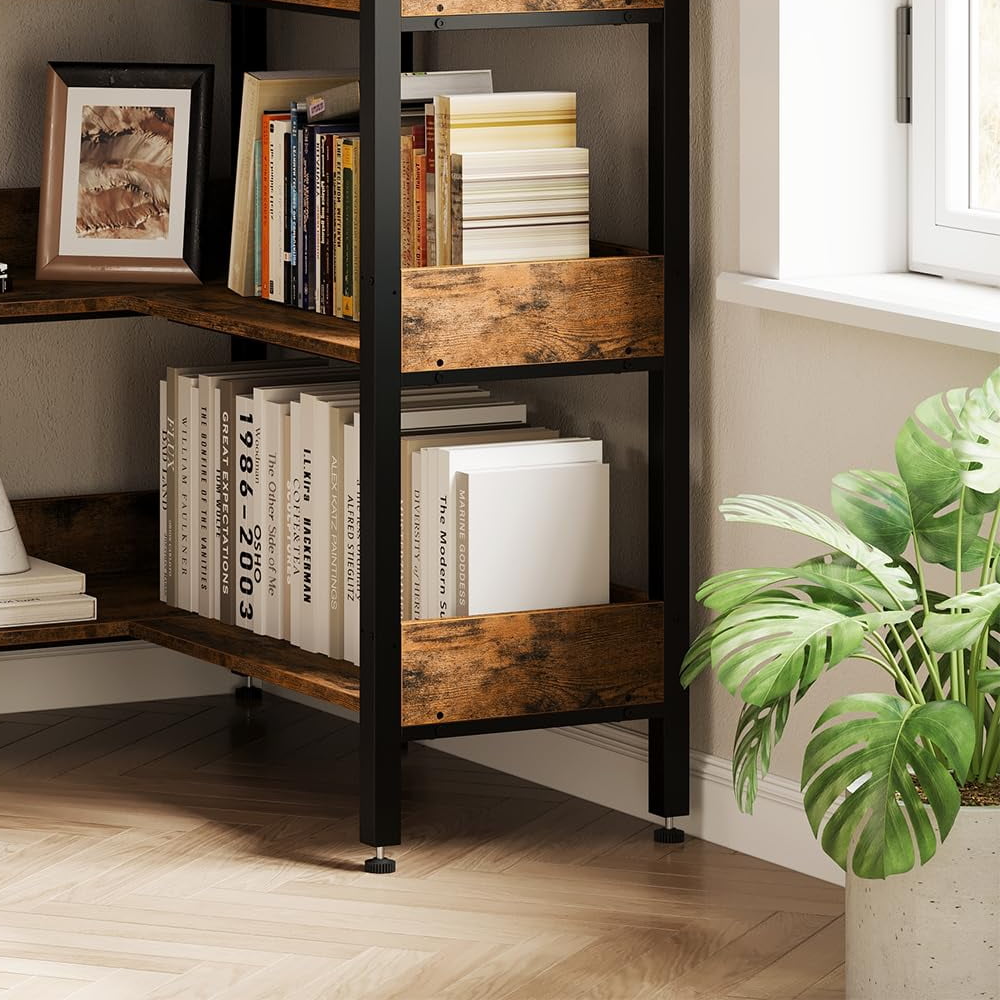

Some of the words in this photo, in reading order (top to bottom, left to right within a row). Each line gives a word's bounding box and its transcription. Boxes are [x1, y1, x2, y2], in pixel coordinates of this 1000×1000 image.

[167, 416, 175, 472] FLUX
[268, 452, 277, 477] The
[330, 455, 338, 490] ALEX
[201, 489, 208, 504] OF
[268, 481, 277, 521] Other
[330, 494, 338, 530] KATZ
[347, 494, 355, 539] ALFRED
[253, 524, 262, 584] OSHO
[268, 525, 277, 554] Side
[268, 557, 277, 574] of
[303, 517, 312, 603] HACKERMAN
[330, 534, 338, 610] PAINTINGS
[347, 543, 355, 601] STIEGLITZ
[440, 530, 448, 595] Modern
[268, 576, 277, 596] Me
